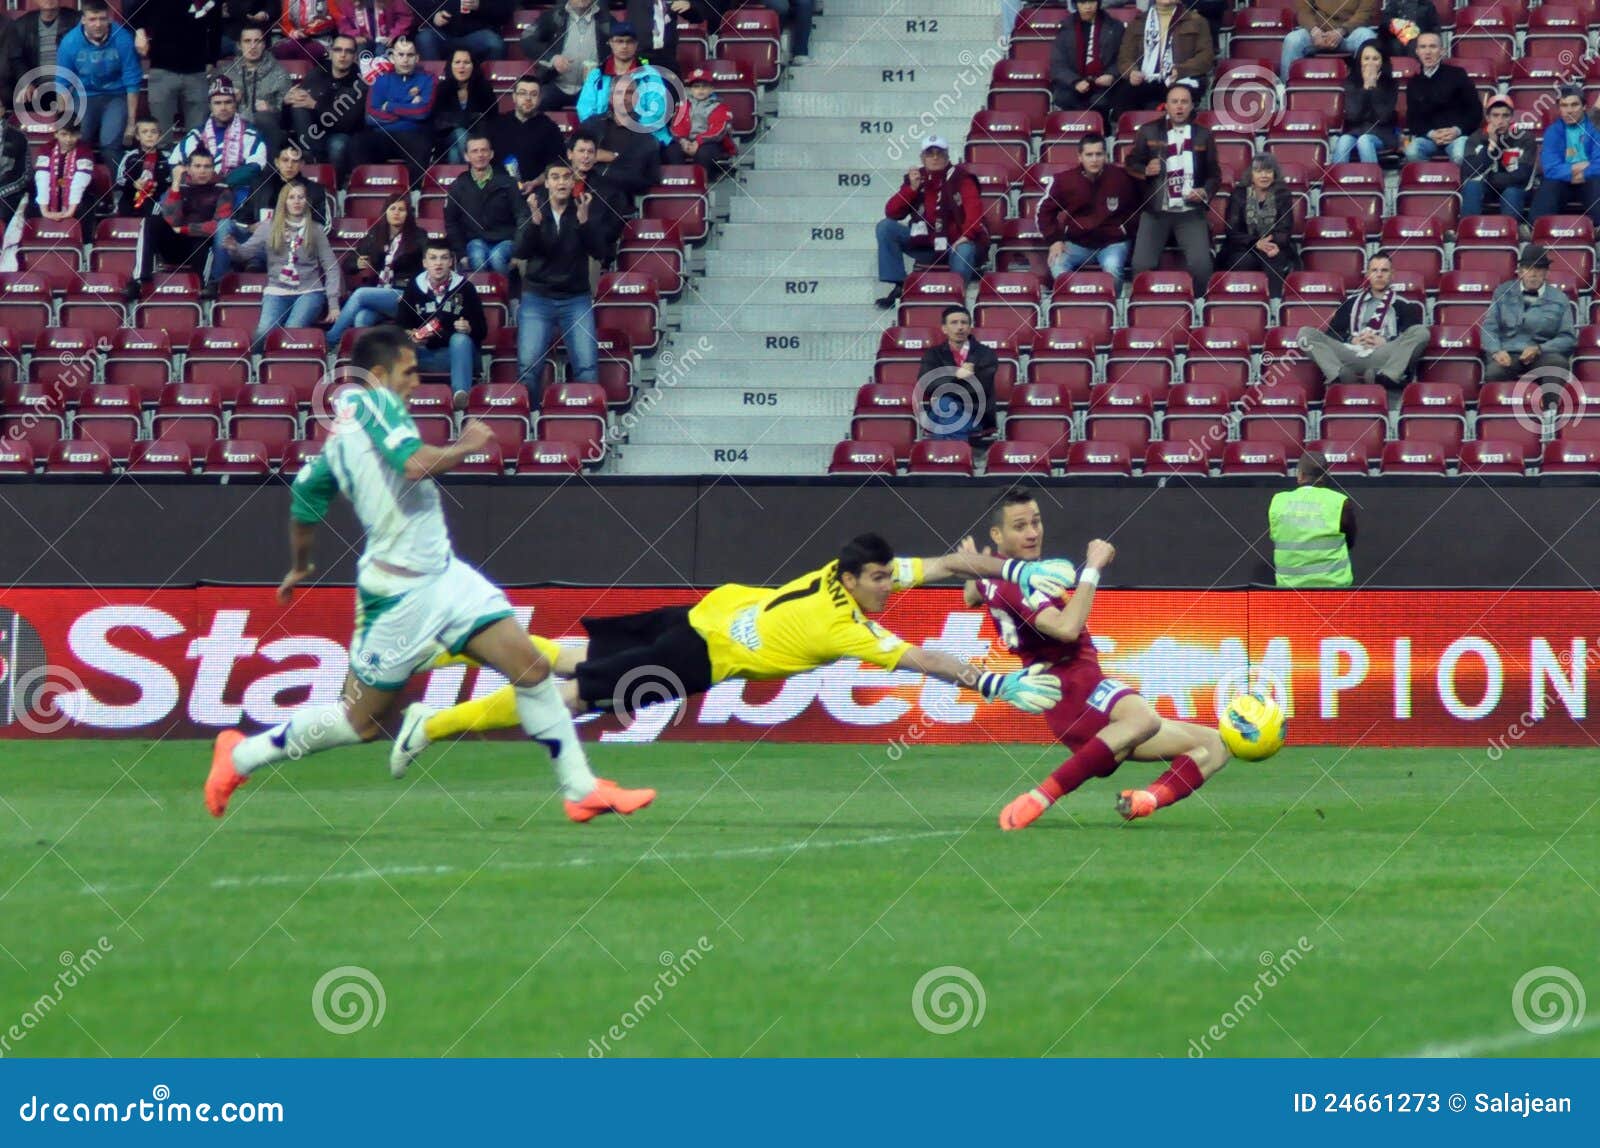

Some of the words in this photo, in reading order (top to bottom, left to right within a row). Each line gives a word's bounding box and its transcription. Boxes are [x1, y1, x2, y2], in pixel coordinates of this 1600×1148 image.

[906, 19, 938, 33] R12
[882, 69, 915, 83] R11
[860, 121, 893, 134] R10
[838, 173, 871, 187] R09
[811, 227, 845, 241] R08
[785, 280, 819, 294] R07
[765, 335, 800, 349] R06
[743, 392, 777, 406] R05
[714, 449, 748, 462] R04
[1090, 635, 1588, 720] AMPION
